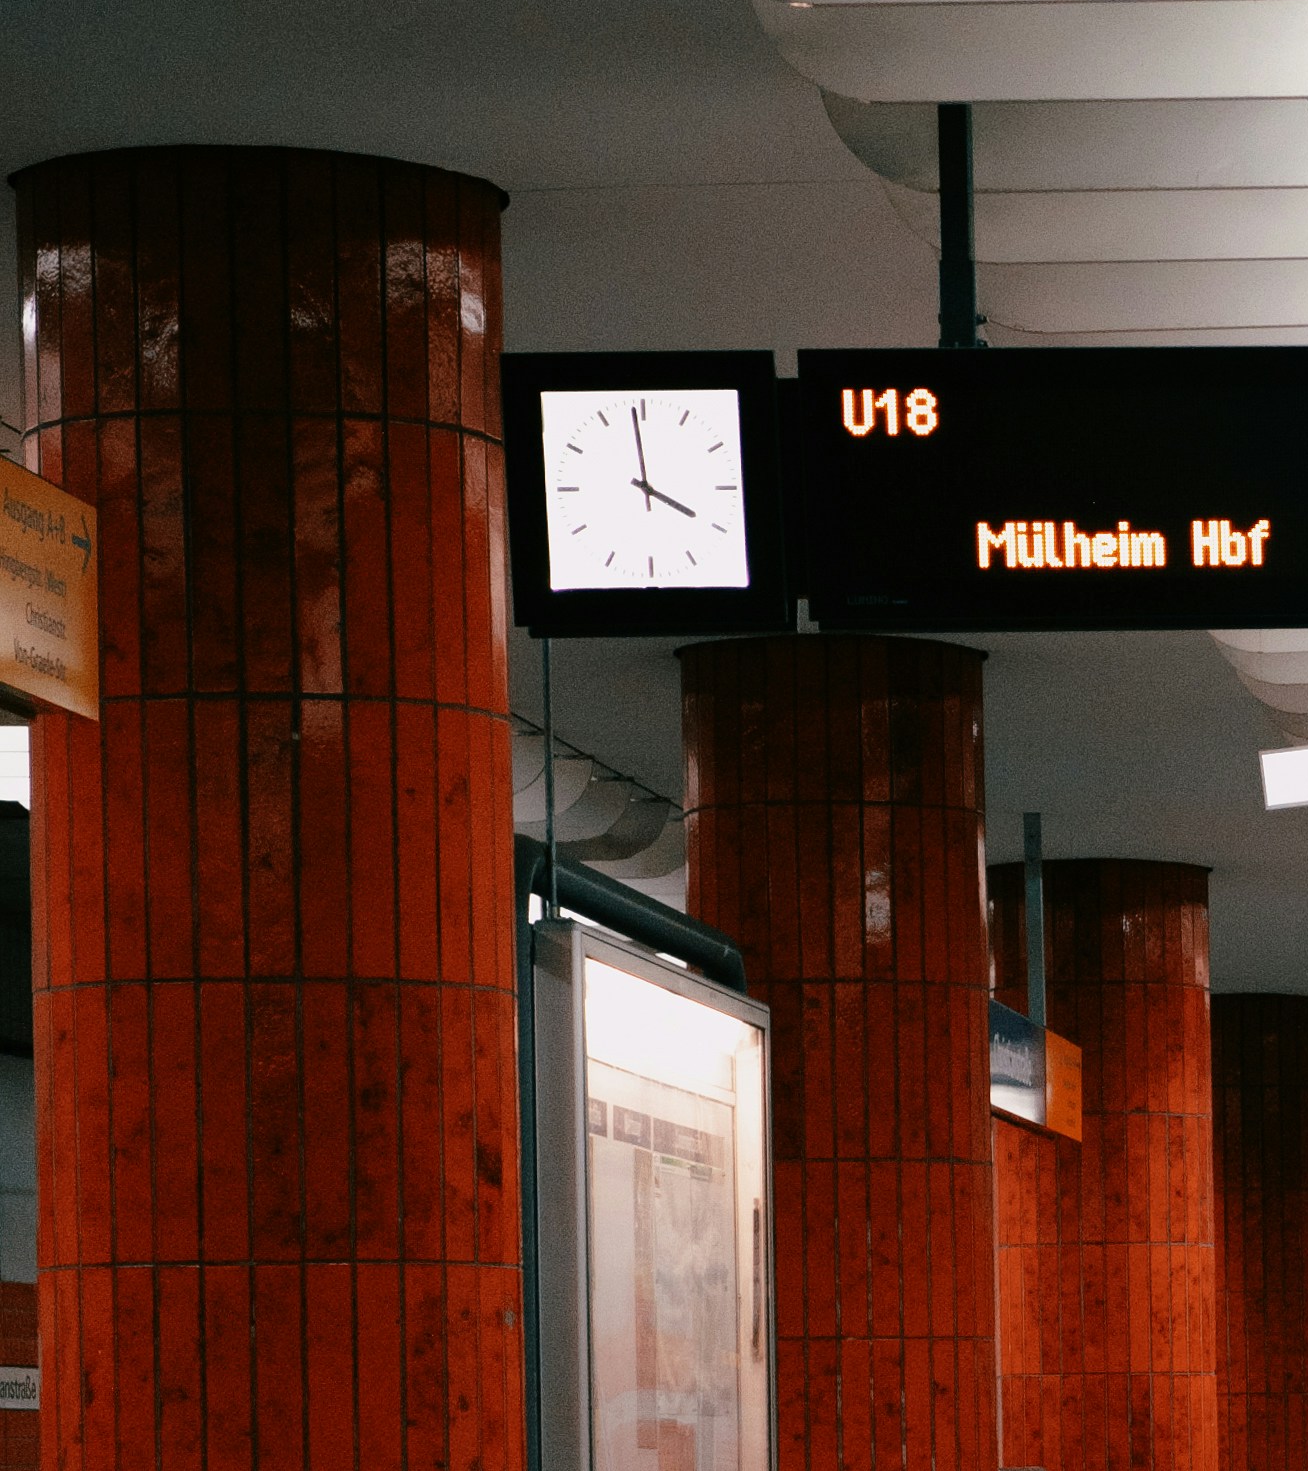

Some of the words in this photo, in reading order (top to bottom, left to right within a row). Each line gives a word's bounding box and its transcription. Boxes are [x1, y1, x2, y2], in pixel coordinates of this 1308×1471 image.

[842, 388, 939, 437] U18
[976, 520, 1167, 570] Mülheim
[1190, 518, 1271, 568] Hbf
